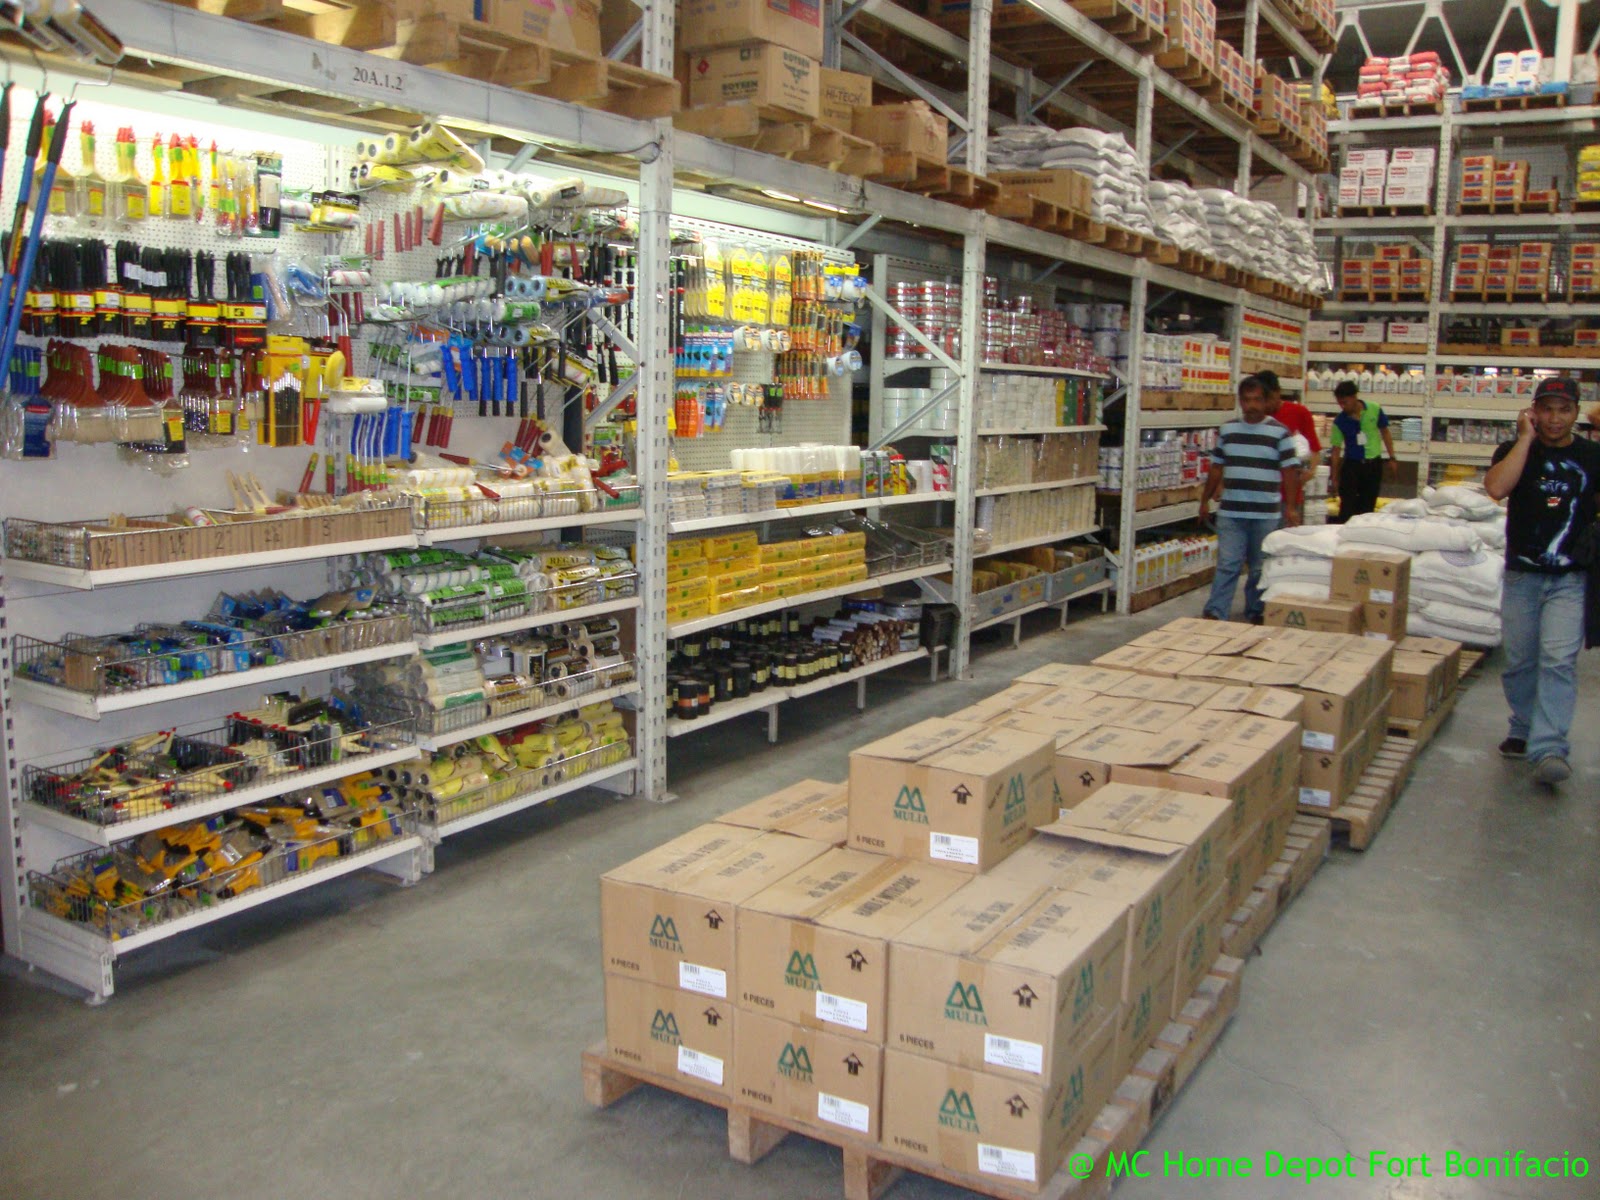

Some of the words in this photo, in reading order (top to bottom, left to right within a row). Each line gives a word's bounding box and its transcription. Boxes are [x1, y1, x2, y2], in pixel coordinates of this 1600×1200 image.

[353, 66, 403, 91] 20A.1.2
[826, 87, 863, 105] HI-TECH
[893, 808, 930, 825] MULIA
[862, 836, 885, 849] PIECES
[649, 937, 684, 954] MULIA
[616, 959, 640, 971] PIECES
[784, 974, 823, 991] MULIA
[743, 992, 748, 1000] 6
[749, 994, 775, 1009] PIECES
[944, 1007, 989, 1026] MULIA
[906, 1034, 934, 1050] PIECES
[778, 1064, 813, 1084] MULIA
[747, 1089, 773, 1104] PIECES
[938, 1113, 980, 1134] MULIA
[900, 1138, 928, 1154] PIECES
